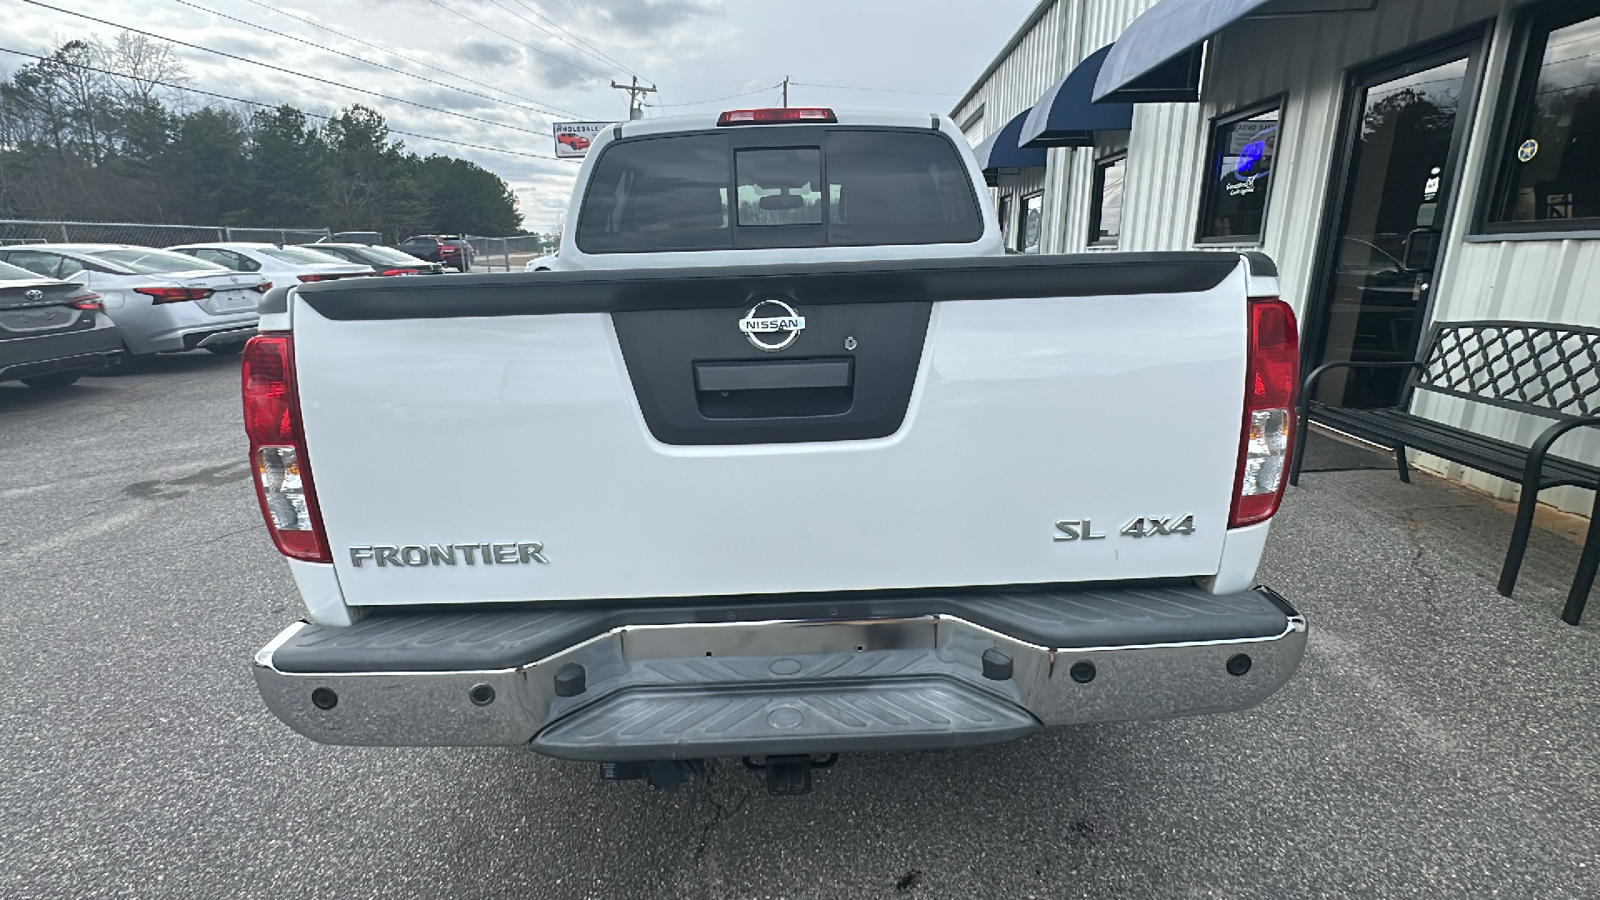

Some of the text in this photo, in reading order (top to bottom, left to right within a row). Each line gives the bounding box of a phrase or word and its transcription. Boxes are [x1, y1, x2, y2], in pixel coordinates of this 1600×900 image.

[556, 125, 599, 133] WHOLESALE
[746, 319, 798, 329] NISSAN
[1053, 518, 1106, 542] SL
[349, 541, 549, 568] FRONTIER
